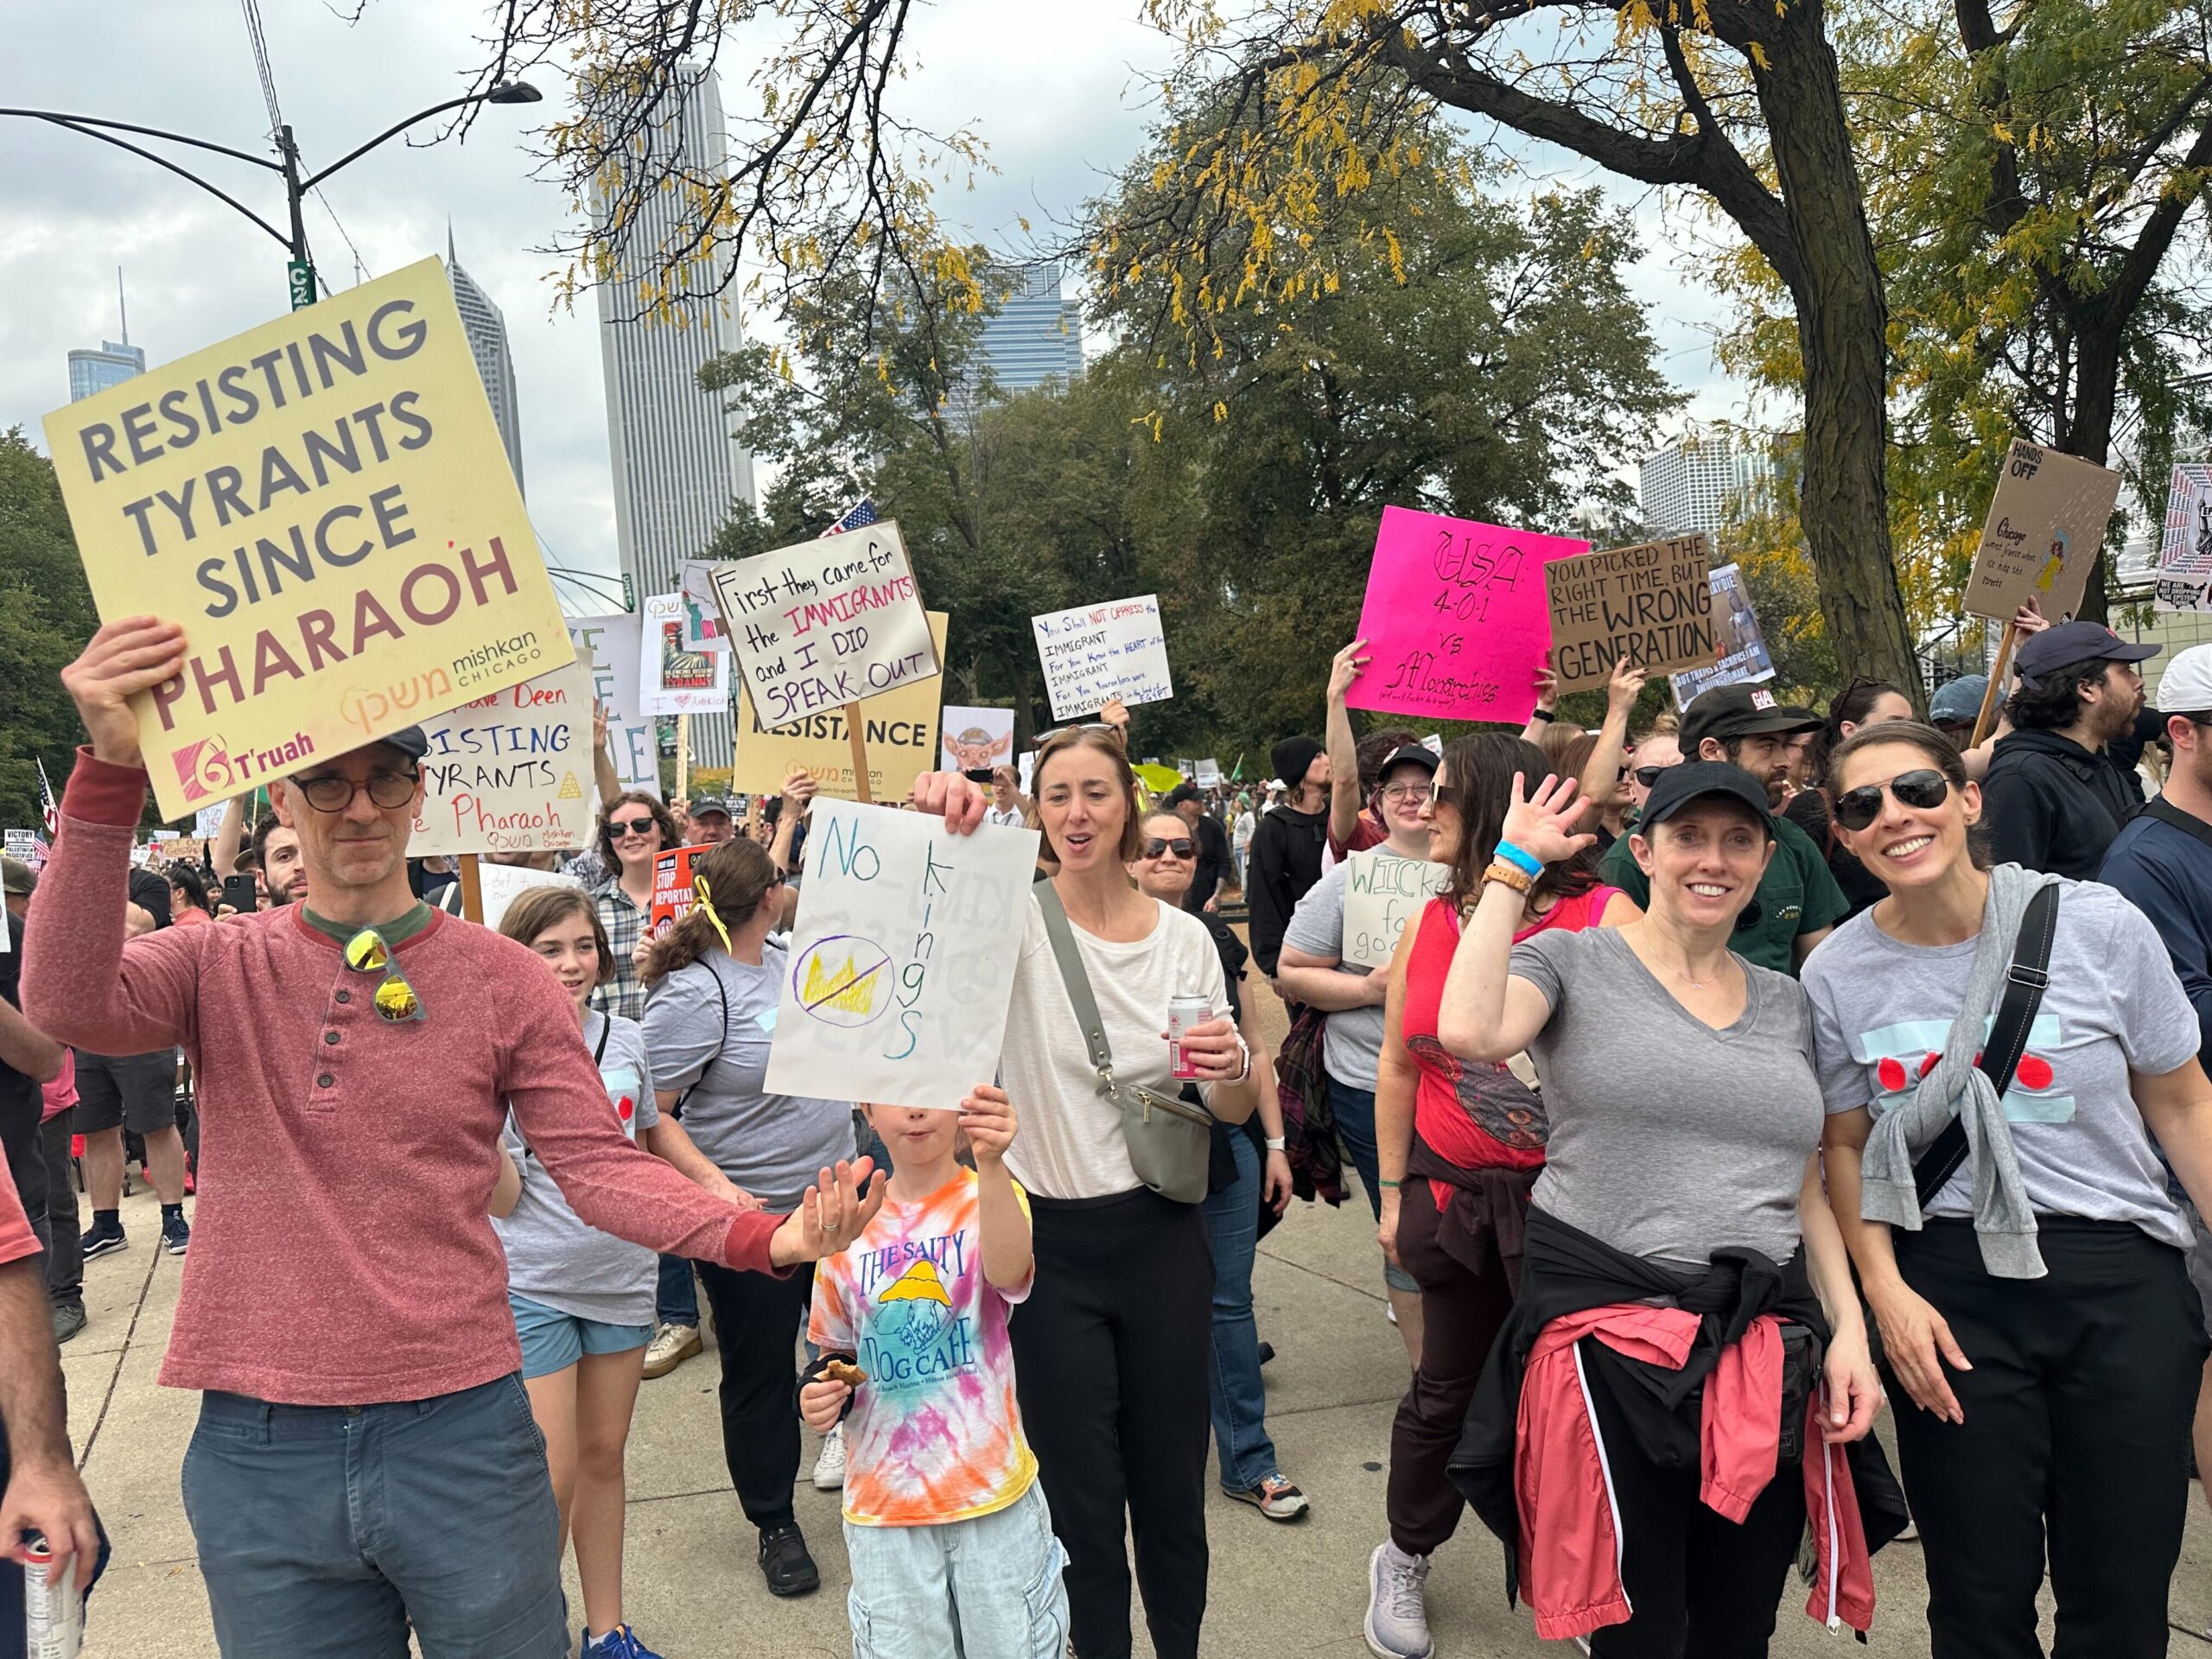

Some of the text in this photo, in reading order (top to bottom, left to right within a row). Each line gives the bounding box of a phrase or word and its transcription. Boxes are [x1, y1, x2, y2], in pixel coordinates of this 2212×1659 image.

[290, 268, 308, 310] C2
[79, 300, 428, 483] RESISTING
[124, 391, 433, 556] TYRANTS
[2012, 442, 2044, 465] HANDS
[2012, 461, 2037, 480] OFF
[195, 484, 416, 620] SINCE
[1997, 518, 2026, 545] Chicago
[715, 541, 893, 619] First they came for
[1547, 537, 1705, 584] YOU PICKED THE
[1550, 578, 1608, 605] RIGHT
[1671, 560, 1705, 584] BUT
[745, 576, 914, 652] the IMMIGRANTS
[1039, 621, 1059, 638] You
[1089, 608, 1107, 626] NOT
[1146, 605, 1156, 614] the
[1554, 582, 1712, 632] THE WRONG
[149, 536, 518, 731] PHARAOH
[453, 631, 537, 674] mishkan
[756, 626, 868, 682] and I DID
[1045, 631, 1107, 657] IMMIGRANT
[1559, 618, 1713, 680] GENERATION
[459, 648, 542, 687] CHICAGO
[1049, 662, 1063, 674] For
[1068, 658, 1081, 669] You
[1108, 648, 1120, 658] the
[1124, 639, 1147, 653] HEART
[1051, 663, 1109, 688] IMMIGRANT
[1676, 675, 1689, 688] BUT
[1718, 652, 1746, 672] SACRIFICE
[665, 677, 713, 688] TYRANNY
[766, 652, 924, 720] SPEAK OUT
[1056, 691, 1071, 702] For
[1132, 671, 1147, 681] were
[1140, 686, 1168, 703] EGYPT
[1056, 692, 1123, 717] IMMIGRANTS
[753, 715, 926, 747] SISTNCE
[235, 731, 315, 781] T'ruah
[842, 767, 882, 778] mian
[451, 793, 561, 836] Pharaoh
[818, 817, 880, 880] No
[655, 888, 693, 906] DEPORTAT
[657, 871, 676, 890] STOP
[1382, 899, 1406, 934] fo
[883, 841, 954, 1059] Kings
[859, 1229, 966, 1297] THE SALTY
[864, 1317, 975, 1382] DOG CAFE
